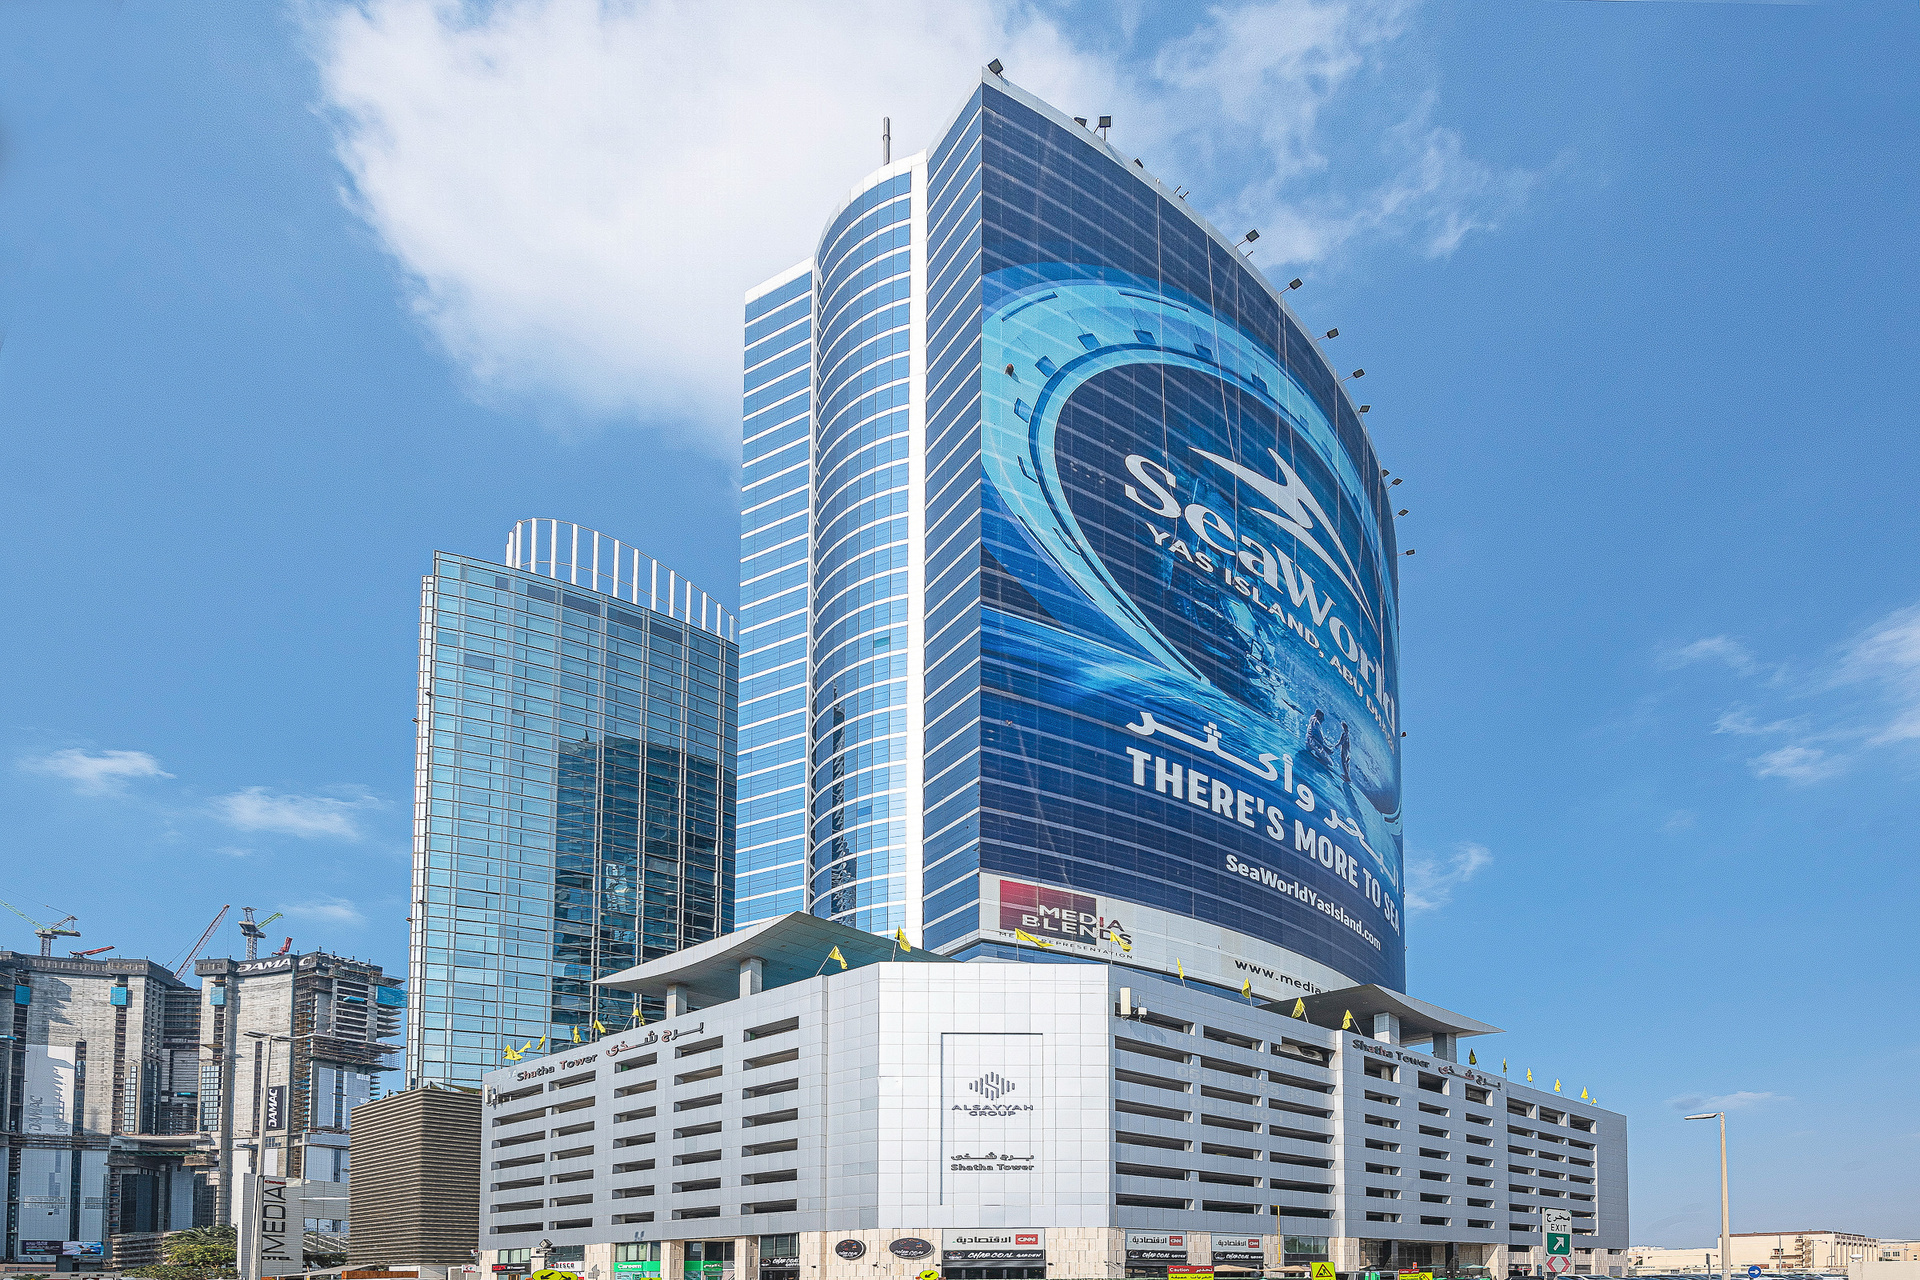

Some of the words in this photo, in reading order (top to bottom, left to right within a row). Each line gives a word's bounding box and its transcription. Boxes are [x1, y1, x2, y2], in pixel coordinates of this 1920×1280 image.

[1124, 454, 1396, 737] SeaWorld
[1145, 522, 1215, 573] YAS
[1224, 568, 1325, 658] ISLAND,
[1329, 655, 1364, 698] ABU
[1125, 746, 1285, 841] THERE'S
[1294, 819, 1359, 889] MORE
[1362, 867, 1381, 909] TO
[1383, 891, 1400, 938] SEA
[1323, 808, 1399, 894] البحر
[1039, 904, 1125, 933] MEDIA
[1225, 853, 1382, 951] SeaWorldYasIsland.com
[1022, 914, 1133, 945] BLENDS
[236, 956, 312, 973] DAMAC
[1234, 959, 1332, 995] www.media
[516, 1064, 555, 1081] Shatha
[559, 1053, 598, 1070] Tower
[1352, 1039, 1393, 1059] Shatha
[1395, 1051, 1430, 1068] Tower
[28, 1094, 43, 1132] DAMAC
[268, 1088, 279, 1128] DAMAC
[950, 1163, 994, 1171] Shatha
[996, 1163, 1035, 1171] Tower
[262, 1185, 287, 1254] MEDIA
[1546, 1212, 1571, 1223] مخرج
[1550, 1223, 1567, 1232] EXIT
